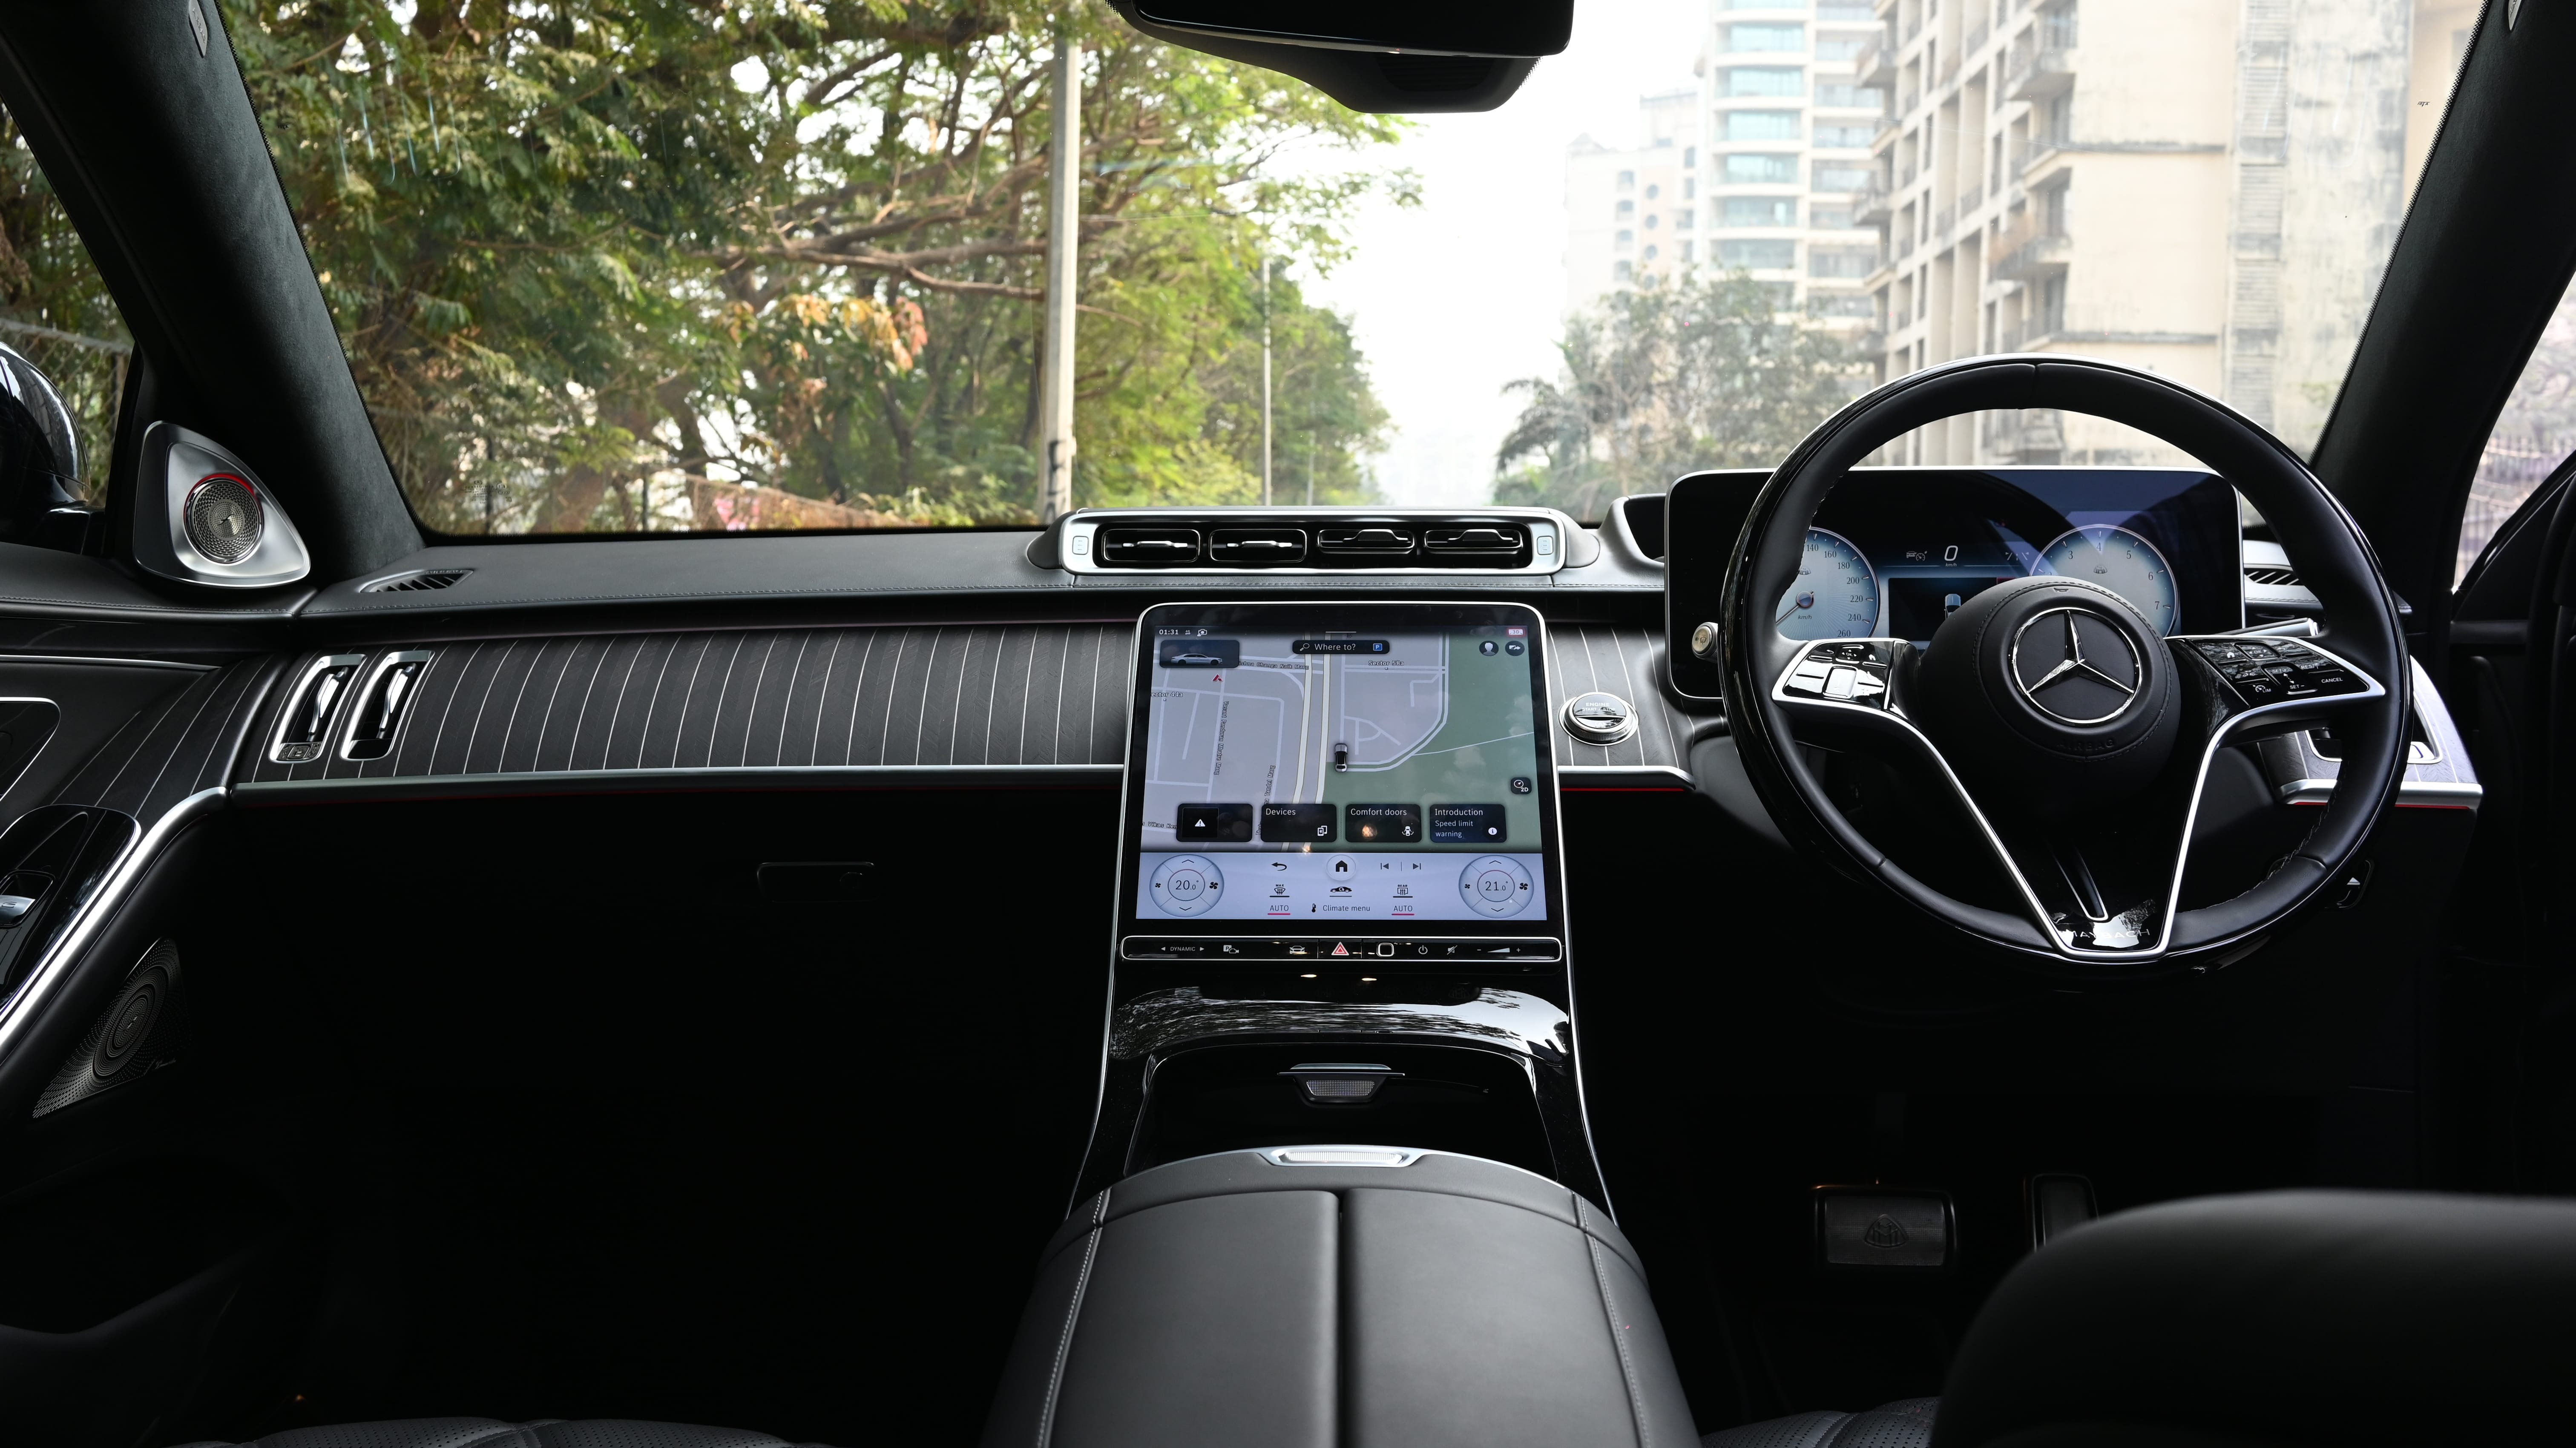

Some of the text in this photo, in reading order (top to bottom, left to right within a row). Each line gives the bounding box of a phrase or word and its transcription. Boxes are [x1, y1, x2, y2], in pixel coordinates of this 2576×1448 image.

[2097, 543, 2102, 551] 4
[1944, 546, 1958, 561] 0
[2068, 551, 2073, 559] 3
[2126, 550, 2131, 559] 5
[2148, 572, 2153, 580] 6
[2155, 601, 2159, 610] 7
[2056, 739, 2115, 751] AIRBAG
[1213, 762, 1222, 776] Marg
[1268, 765, 1276, 779] Marg
[1435, 830, 1463, 839] warning
